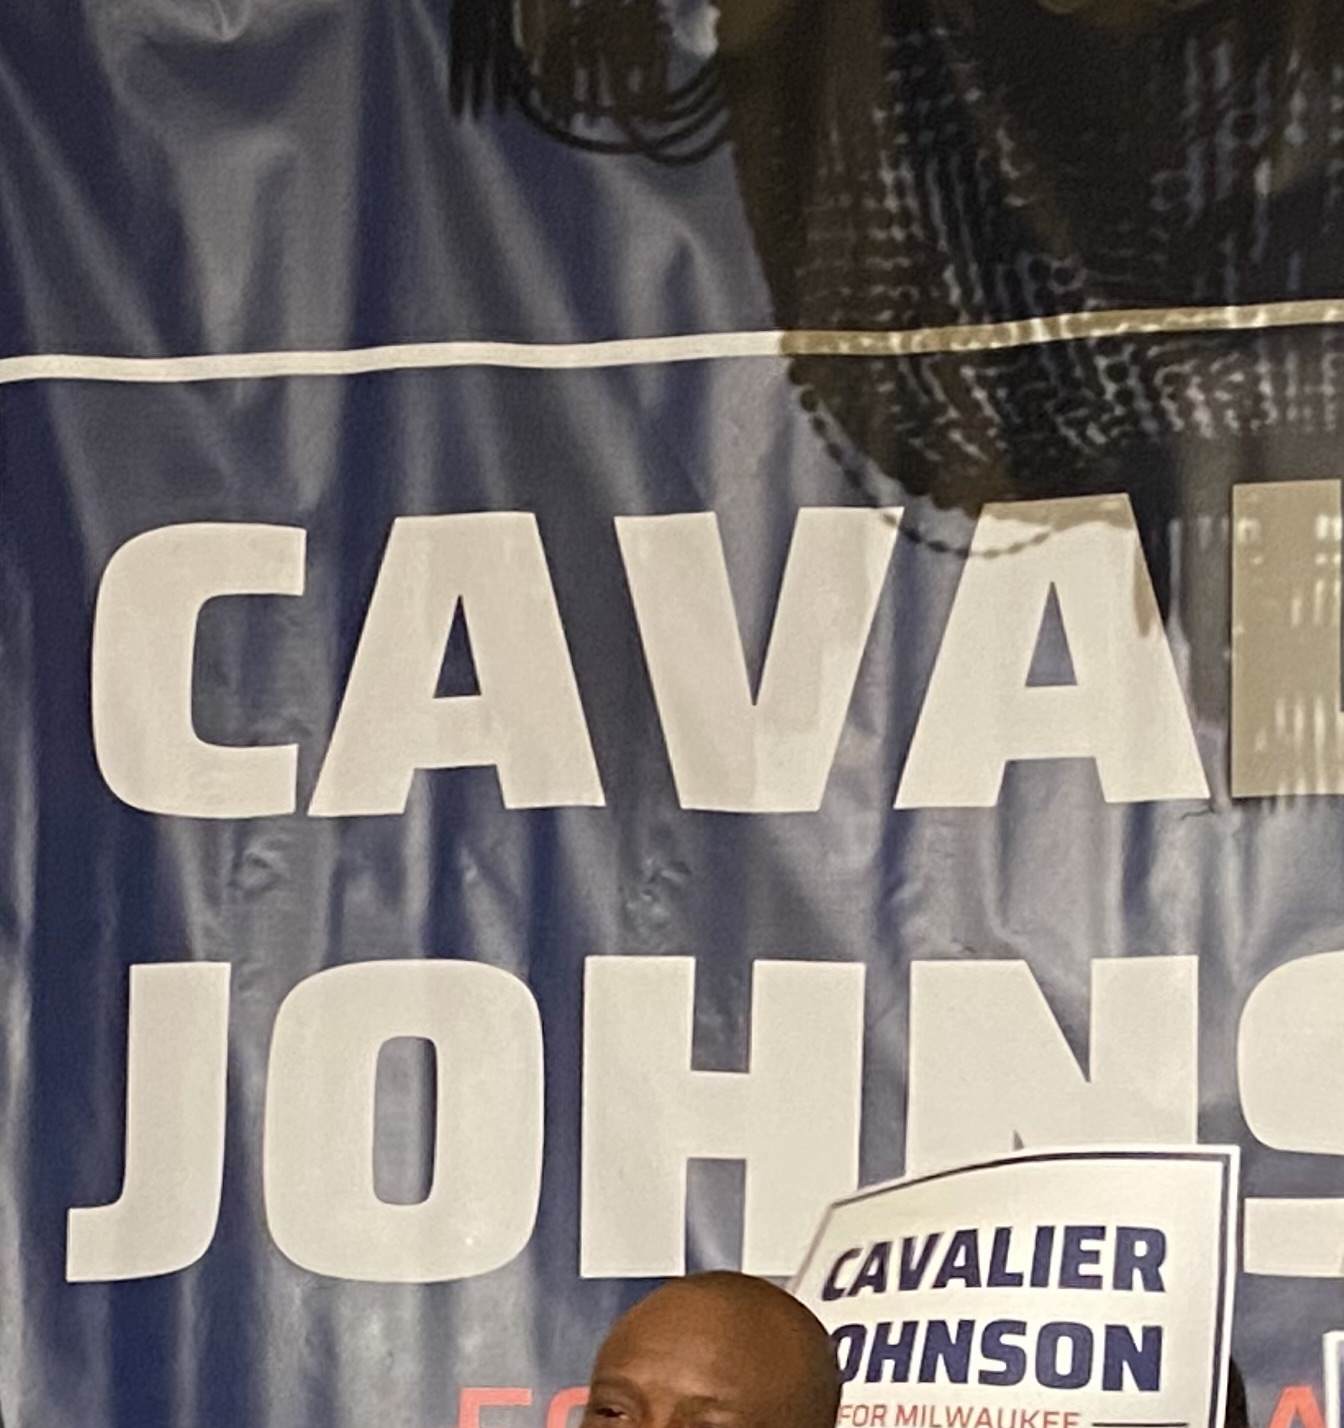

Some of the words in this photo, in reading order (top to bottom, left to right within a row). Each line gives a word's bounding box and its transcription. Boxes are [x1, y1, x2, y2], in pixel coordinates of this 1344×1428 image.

[822, 1225, 1167, 1301] CAVALIER
[831, 1319, 1163, 1392] OHNSON
[838, 1404, 887, 1428] FOR
